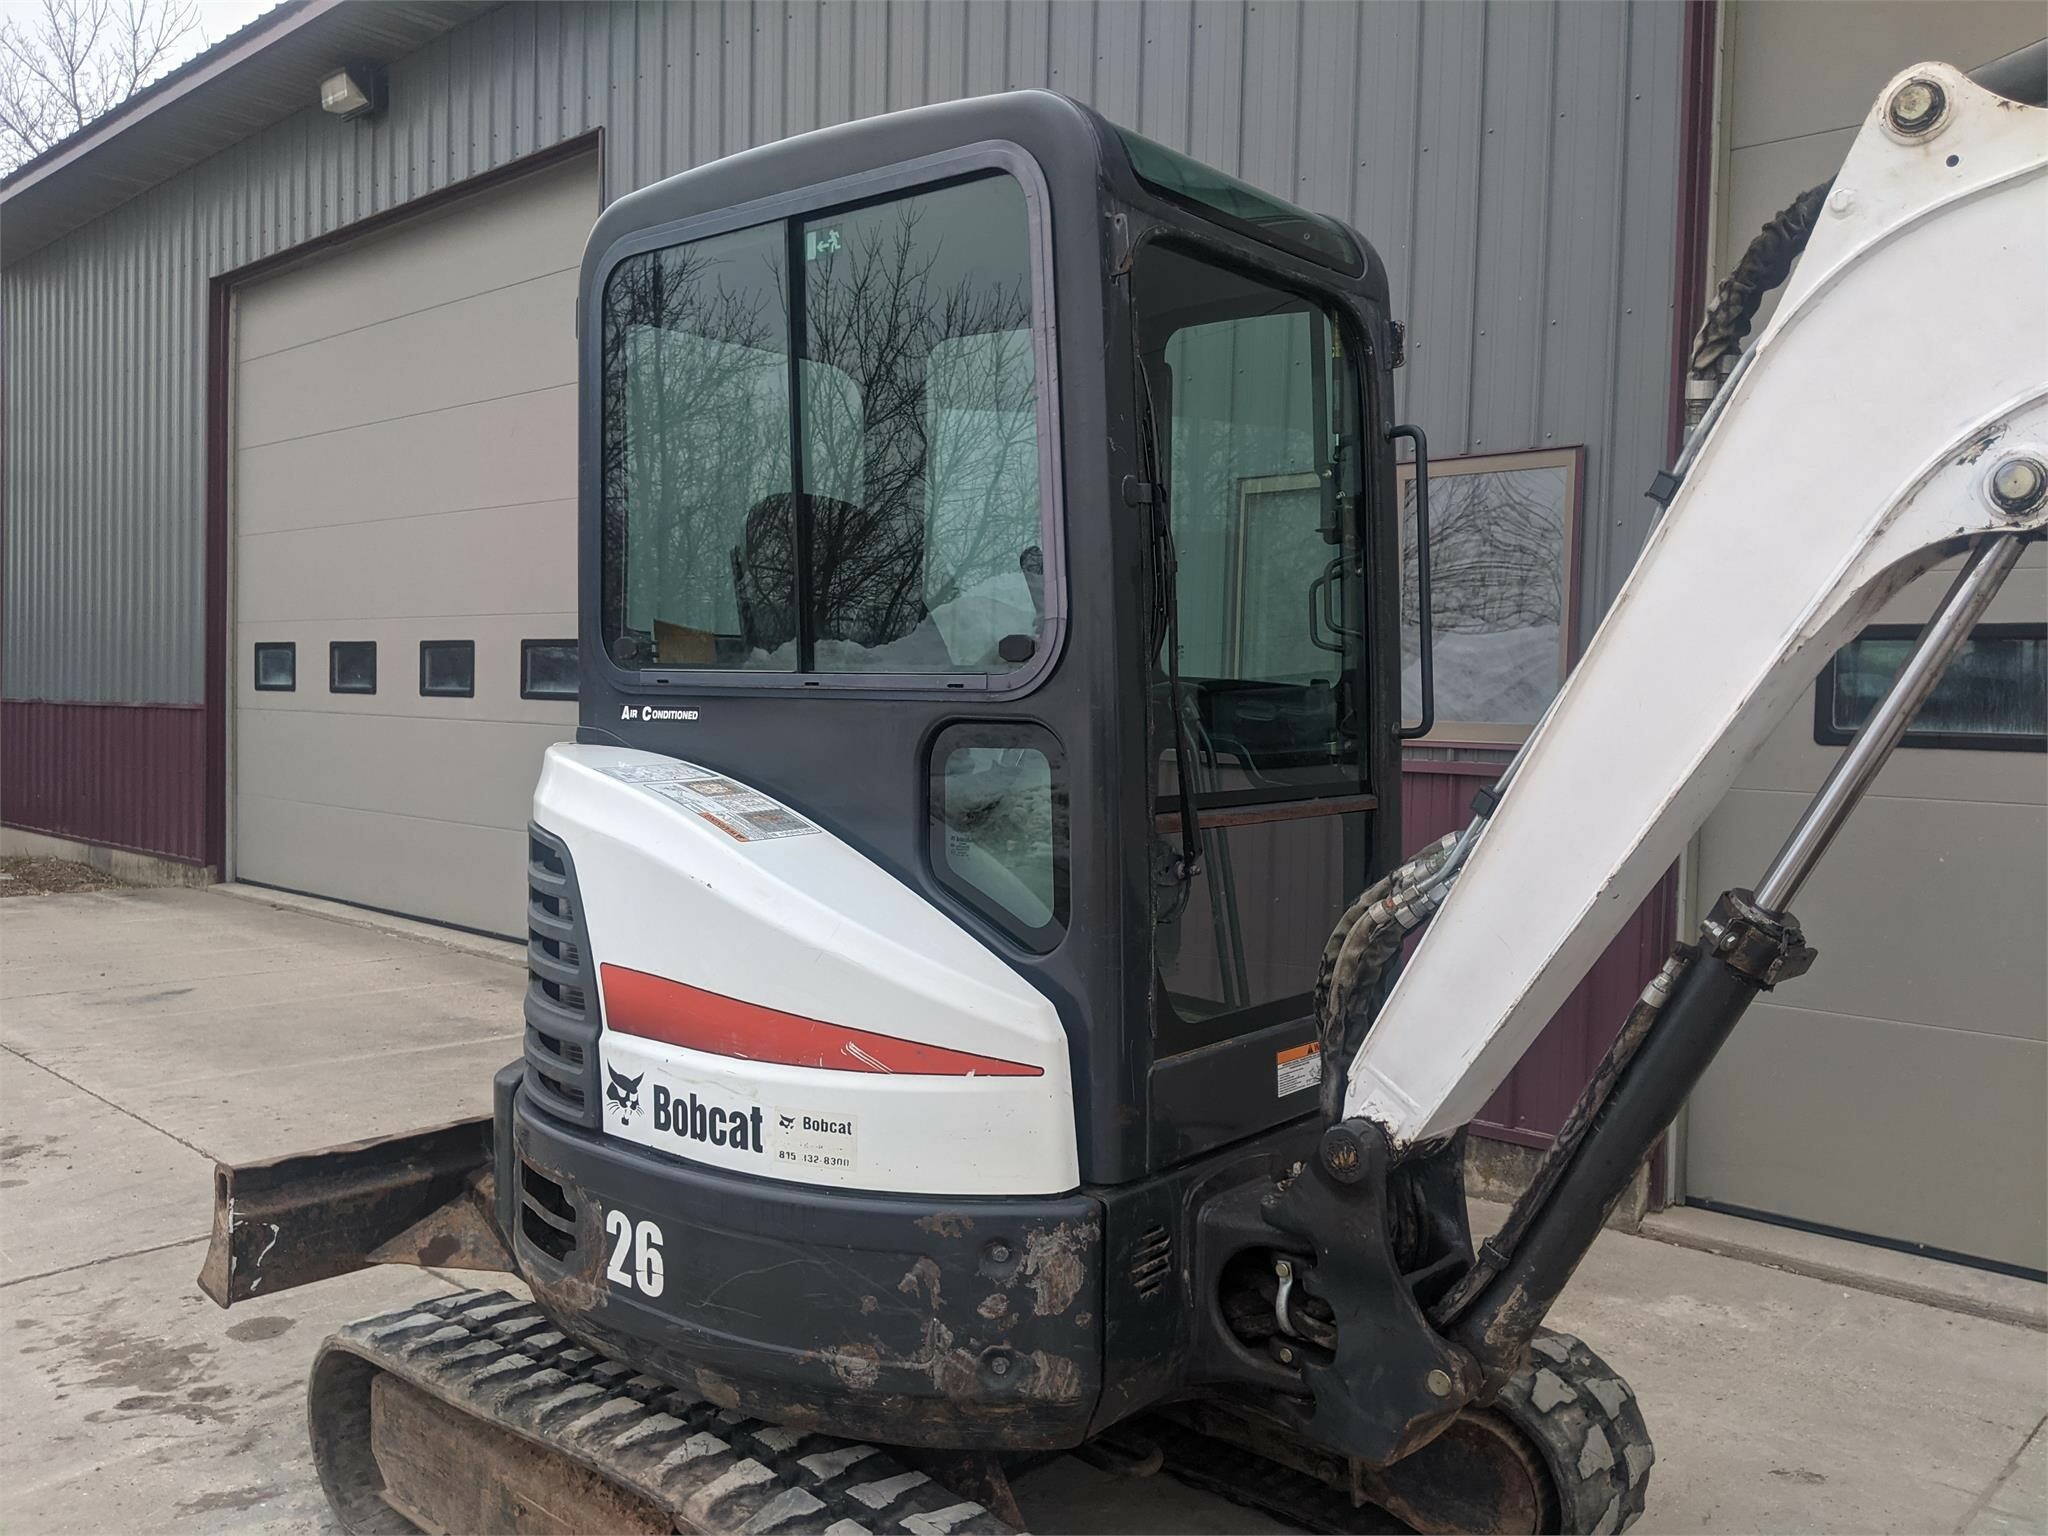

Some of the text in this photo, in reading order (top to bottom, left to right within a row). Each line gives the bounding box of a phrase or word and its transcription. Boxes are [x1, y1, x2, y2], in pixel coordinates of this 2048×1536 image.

[652, 1083, 764, 1154] Bobcat
[803, 1116, 852, 1136] Bobcat
[778, 1150, 797, 1161] 815
[606, 1209, 664, 1298] 26
